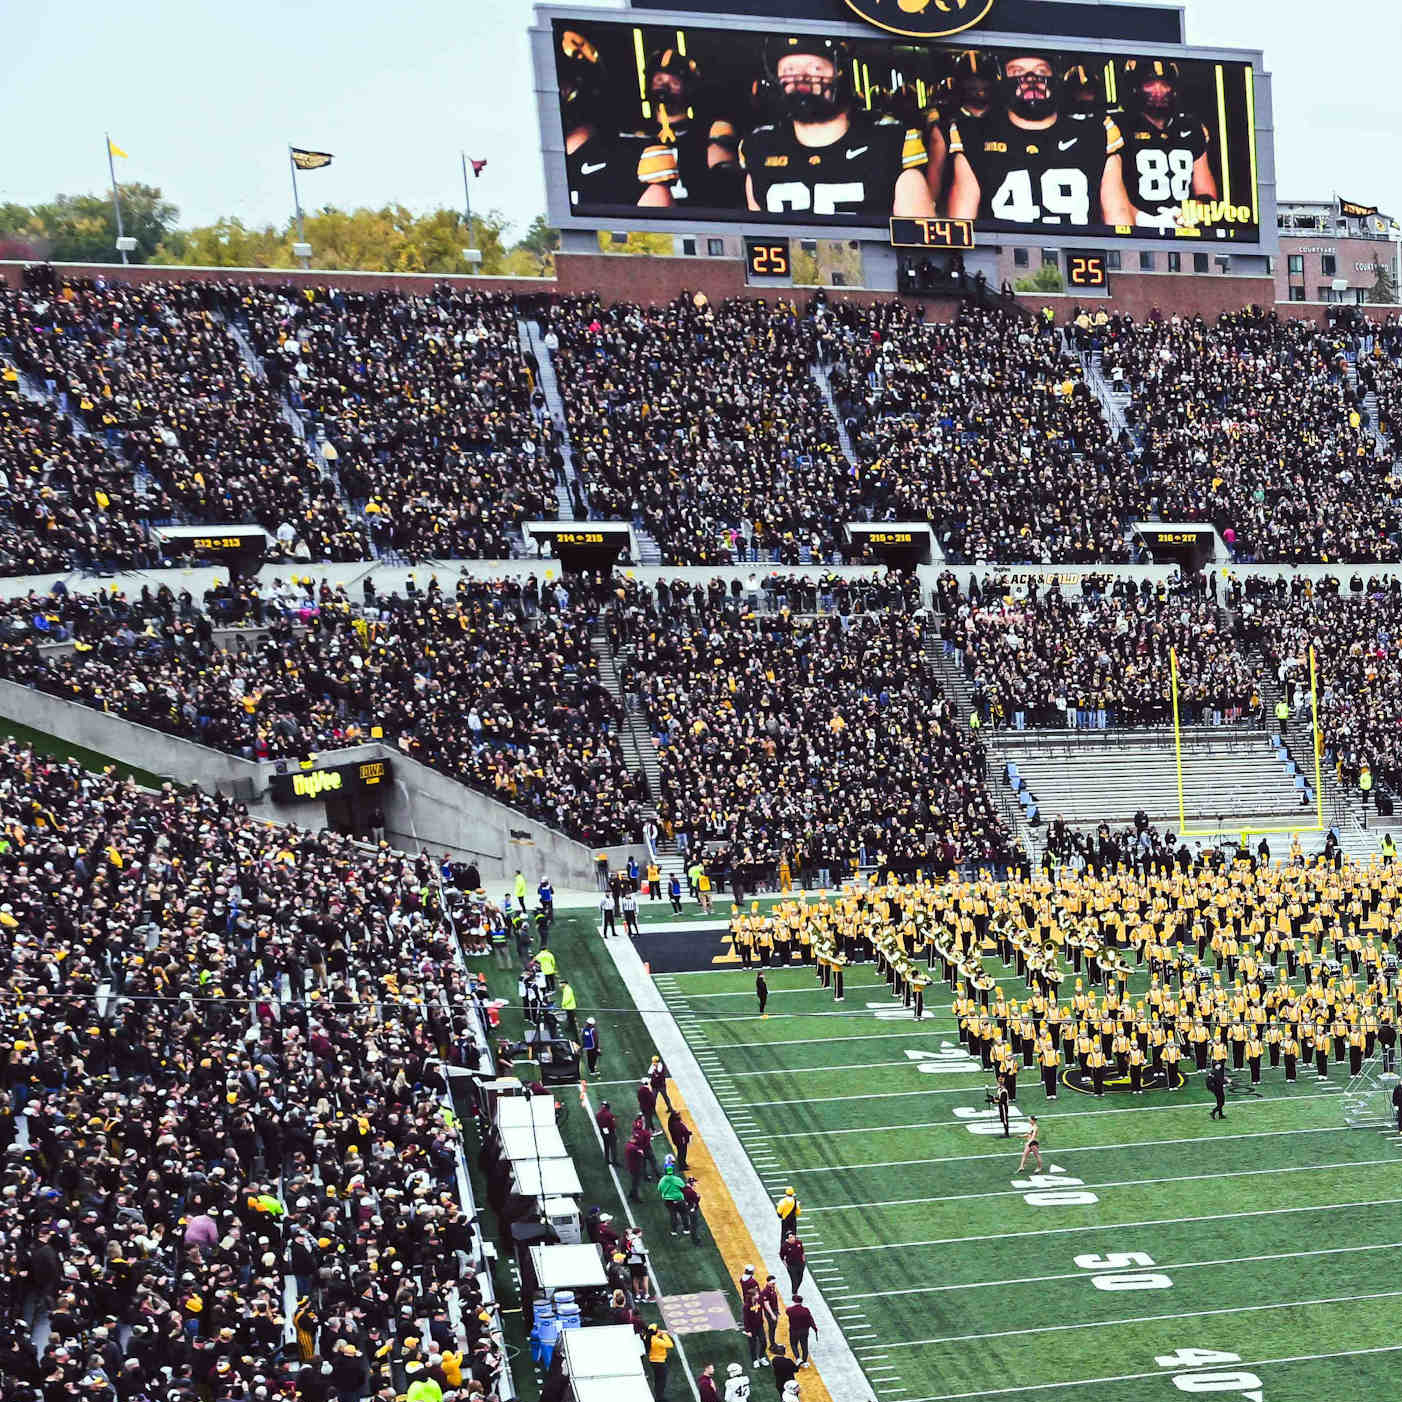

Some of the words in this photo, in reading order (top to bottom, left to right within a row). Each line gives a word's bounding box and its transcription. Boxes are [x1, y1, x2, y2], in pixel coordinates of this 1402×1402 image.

[1135, 149, 1194, 202] 88
[991, 168, 1089, 225] 49
[915, 220, 970, 246] 7:47
[753, 246, 786, 272] 25
[1072, 258, 1103, 283] 25
[1010, 1174, 1100, 1206] 40
[1074, 1252, 1174, 1291] 50
[1154, 1347, 1264, 1393] 40
